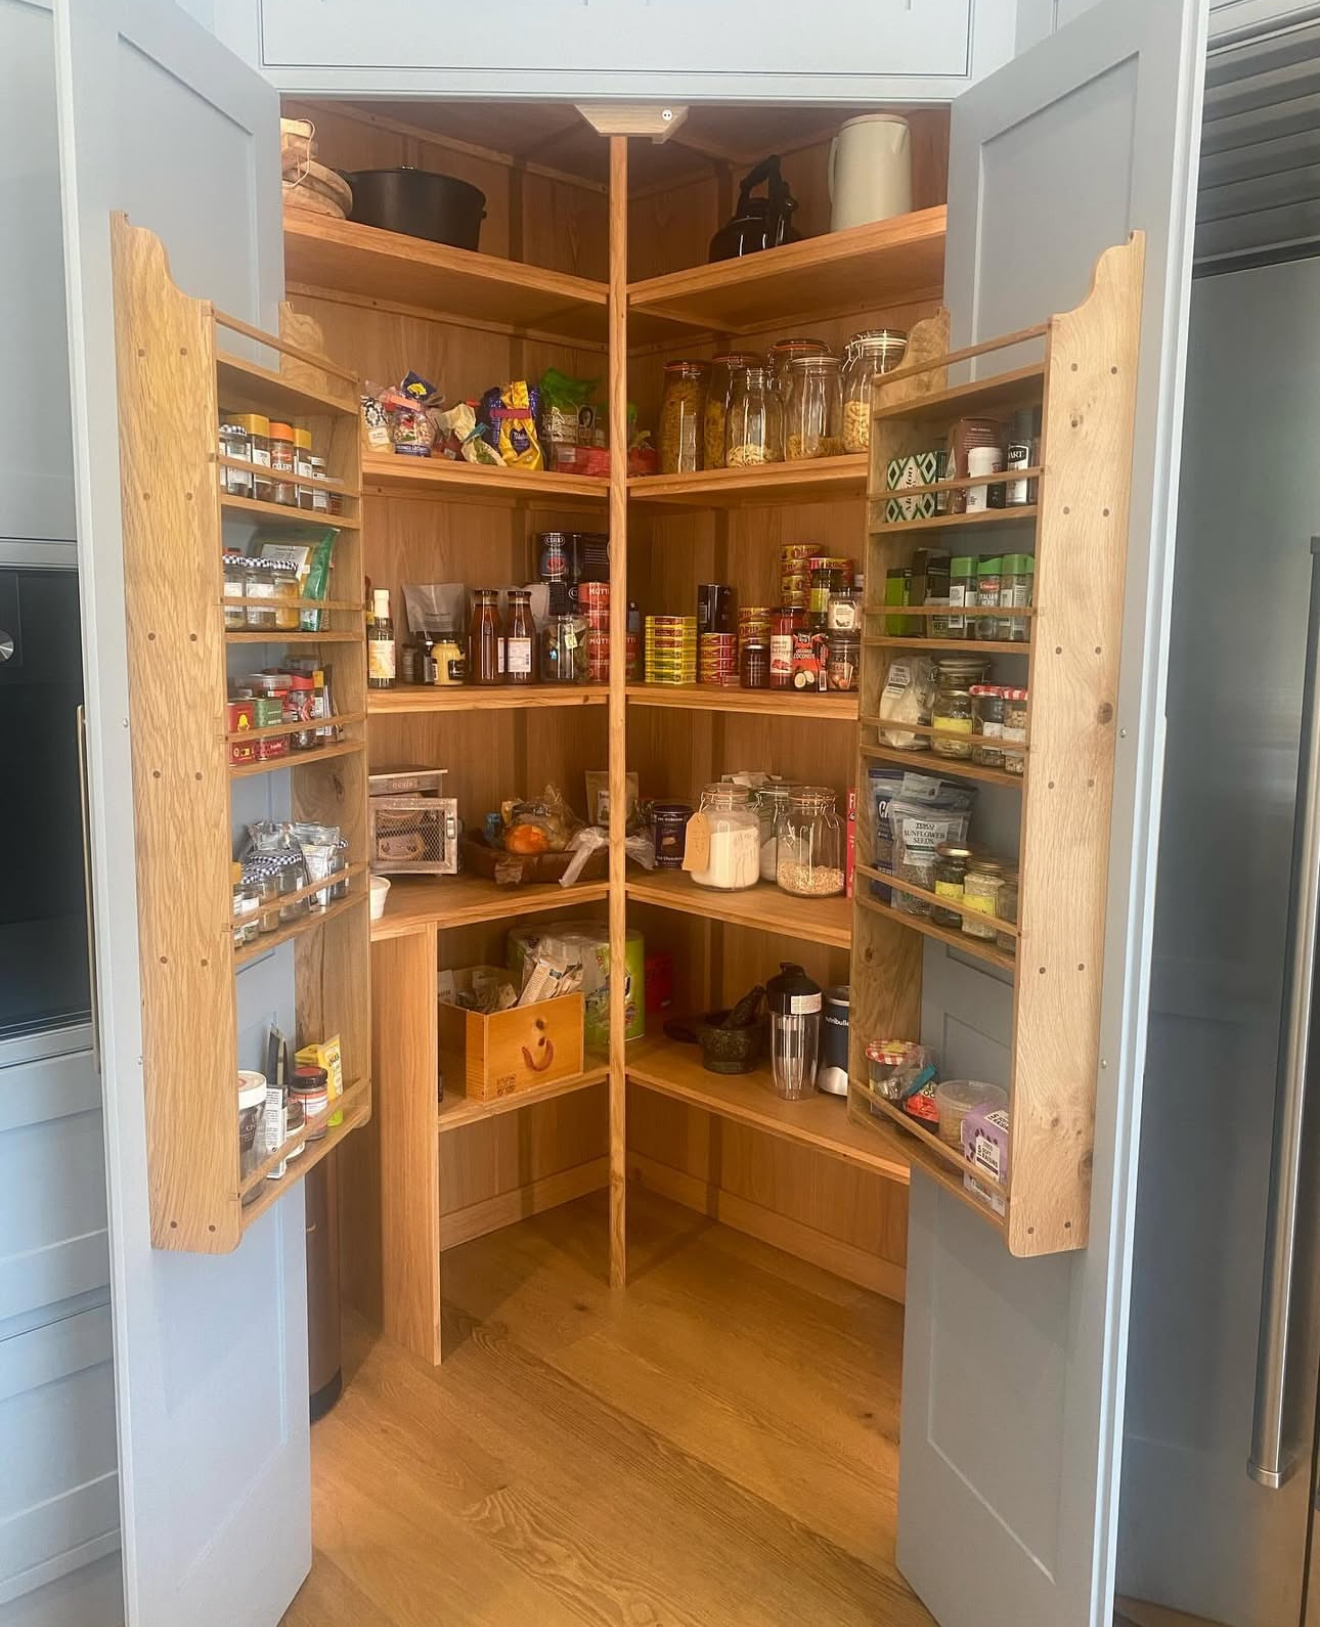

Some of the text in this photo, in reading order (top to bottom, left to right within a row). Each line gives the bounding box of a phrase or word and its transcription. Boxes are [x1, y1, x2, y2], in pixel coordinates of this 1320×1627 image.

[905, 467, 913, 512] Madon
[904, 830, 946, 840] SUNFLOWER
[913, 837, 934, 845] SEEDS
